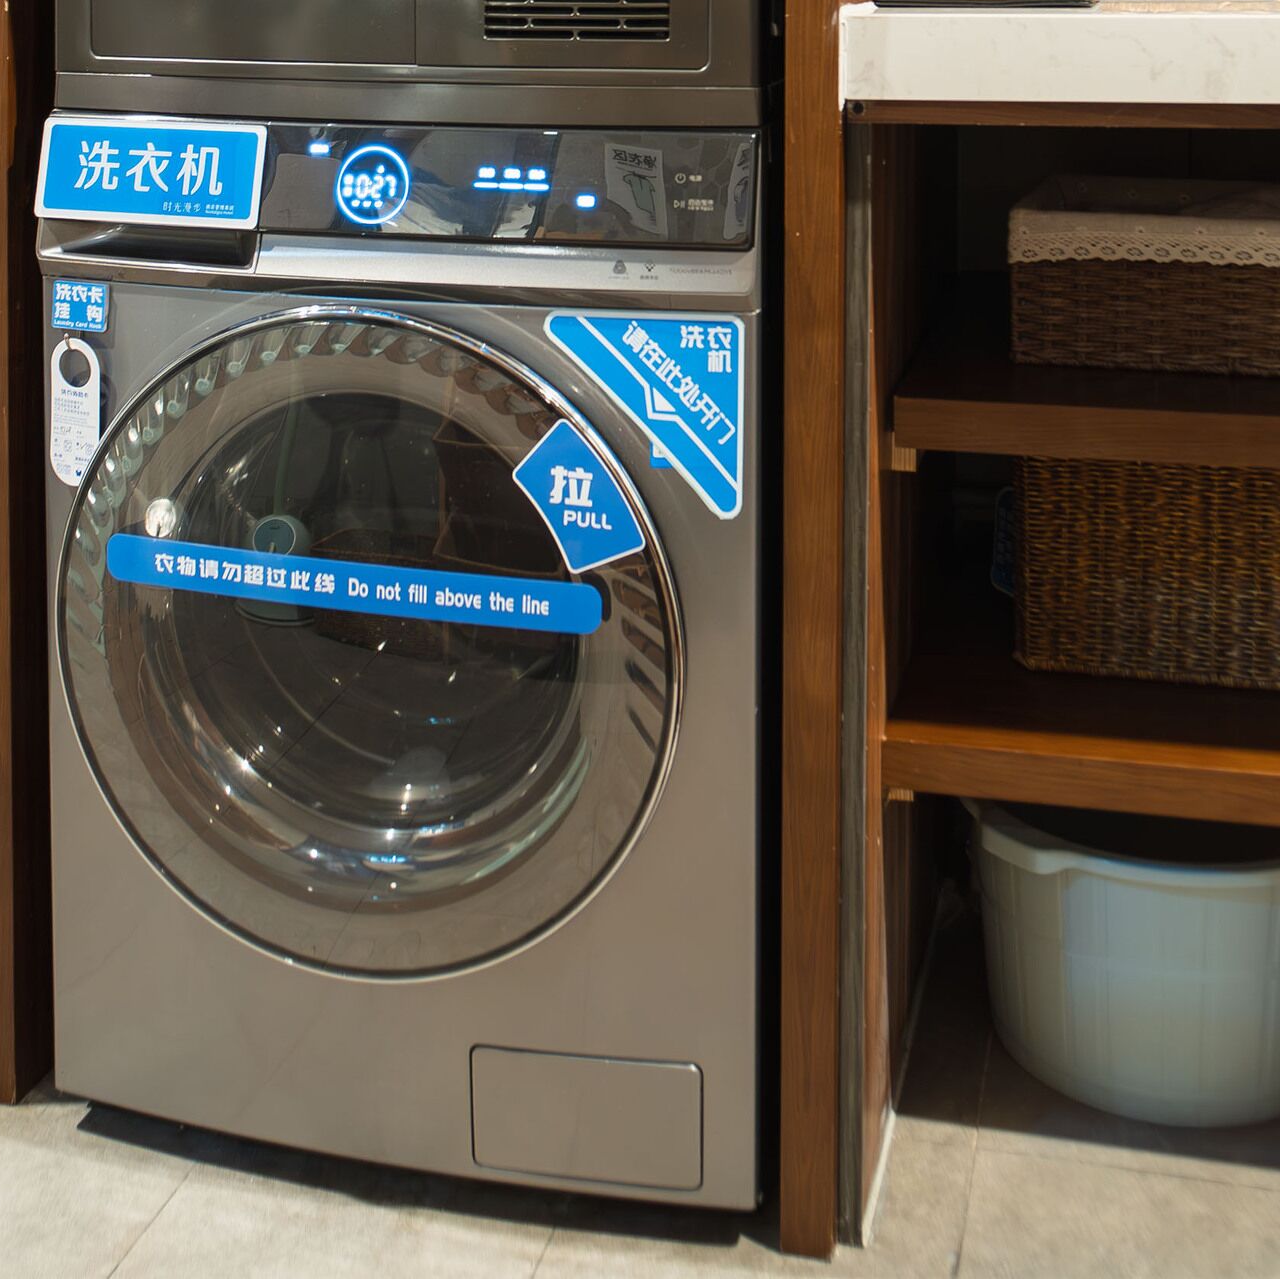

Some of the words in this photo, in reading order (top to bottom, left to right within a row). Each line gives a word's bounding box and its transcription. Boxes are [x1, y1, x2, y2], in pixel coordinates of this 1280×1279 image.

[74, 140, 223, 196] 洗衣机
[55, 283, 103, 303] 洗衣卡
[680, 325, 732, 349] 洗衣
[708, 350, 732, 373] 机
[622, 321, 736, 445] 请在此处开门
[549, 465, 593, 508] 拉
[563, 510, 612, 531] PULL
[154, 553, 335, 594] 衣物请勿超过此线
[348, 577, 369, 598] Do
[376, 582, 401, 601] not
[408, 584, 427, 604] fill
[435, 587, 481, 609] above
[489, 592, 514, 612] the
[522, 595, 550, 616] line
